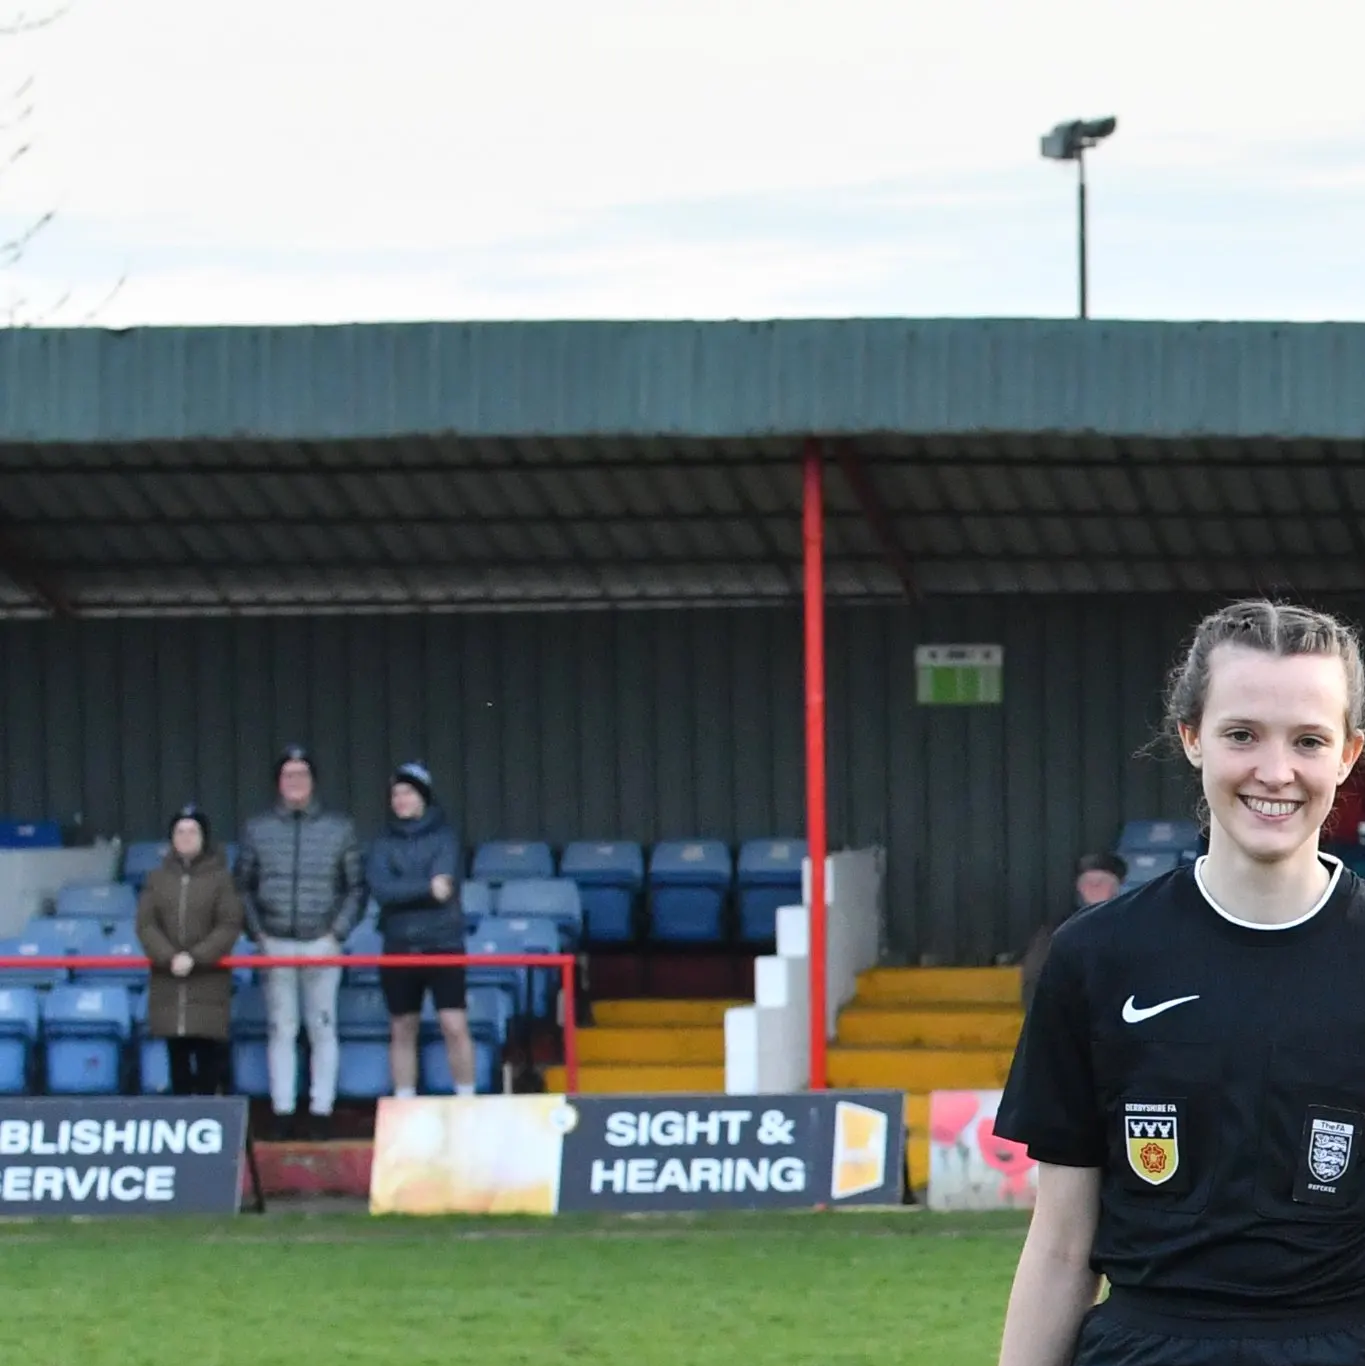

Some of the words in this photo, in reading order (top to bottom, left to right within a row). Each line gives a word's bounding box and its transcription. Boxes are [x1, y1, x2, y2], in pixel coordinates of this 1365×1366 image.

[1124, 1103, 1166, 1113] DERBYSHIRE
[1167, 1104, 1177, 1113] FA
[605, 1109, 751, 1147] SIGHT
[756, 1109, 795, 1145] &
[0, 1166, 175, 1201] ERVICE
[590, 1156, 806, 1194] HEARING
